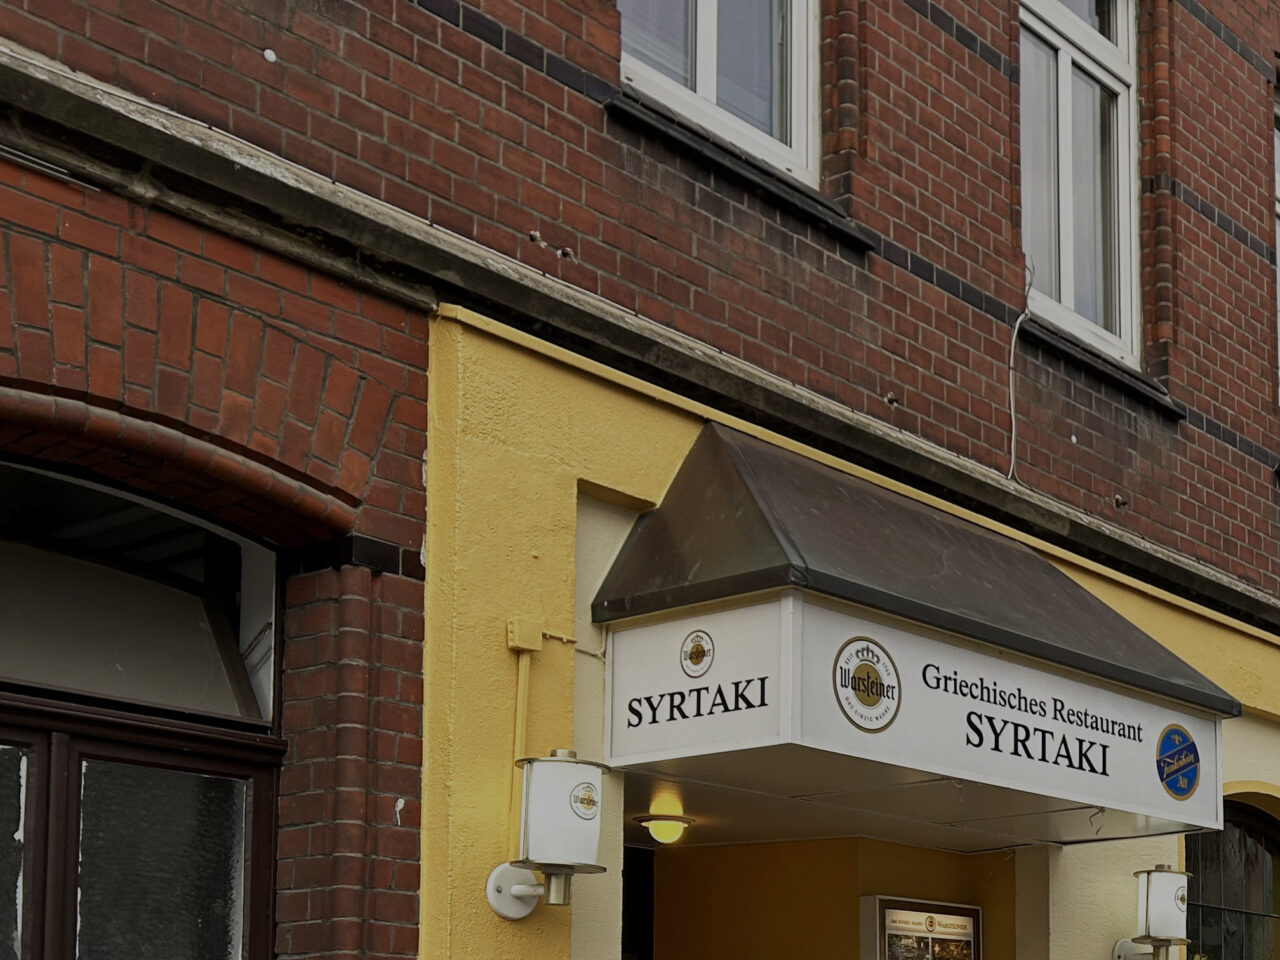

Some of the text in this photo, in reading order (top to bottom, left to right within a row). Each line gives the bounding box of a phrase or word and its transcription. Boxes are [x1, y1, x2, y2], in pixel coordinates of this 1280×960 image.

[627, 676, 769, 729] SYRTAKI
[839, 665, 896, 701] Warsteiner
[921, 663, 1144, 743] Griechisches Restaurant
[966, 711, 1110, 777] SYRTAKI
